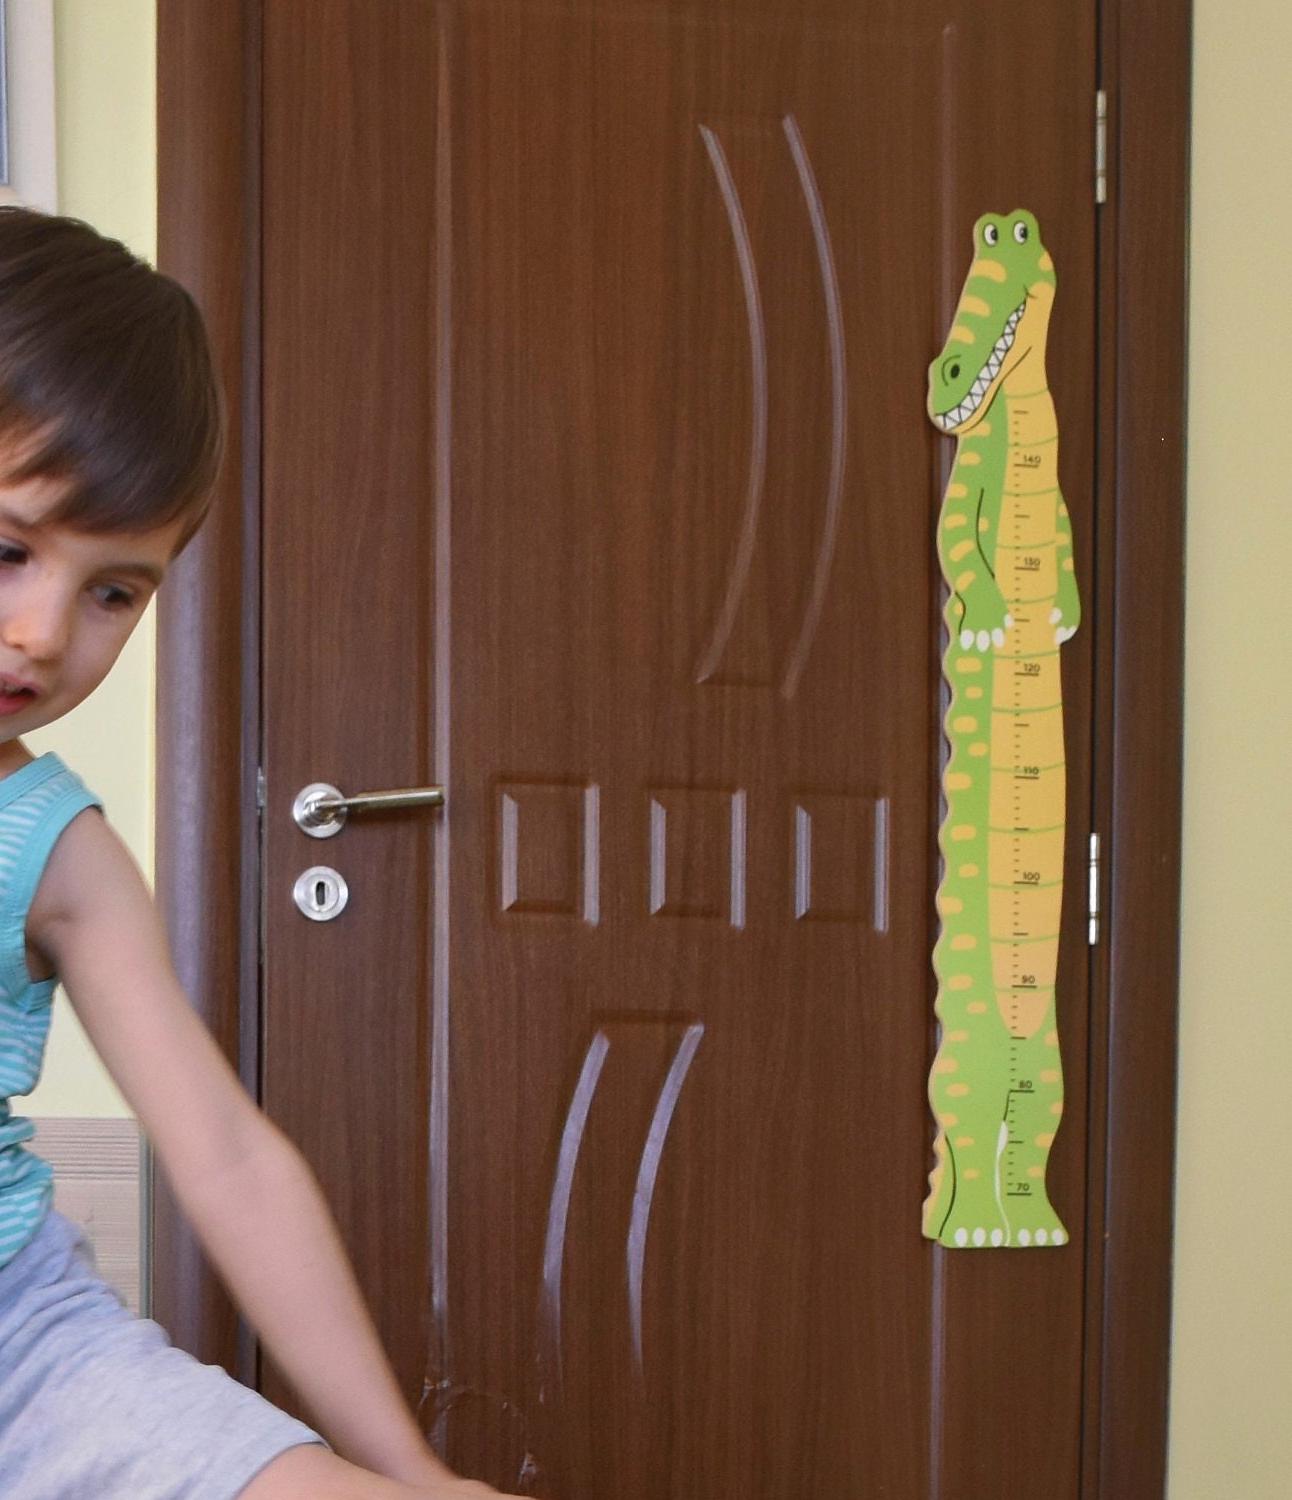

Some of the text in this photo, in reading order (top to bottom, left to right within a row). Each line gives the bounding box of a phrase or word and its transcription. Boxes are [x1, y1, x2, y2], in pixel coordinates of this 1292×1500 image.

[1023, 455, 1041, 464] 140
[1024, 557, 1041, 566] 130
[1023, 663, 1040, 672] 120
[1023, 766, 1039, 775] 110
[1023, 871, 1040, 880] 100
[1021, 974, 1036, 984] 90
[1019, 1080, 1032, 1088] 80
[1017, 1182, 1029, 1191] 70
